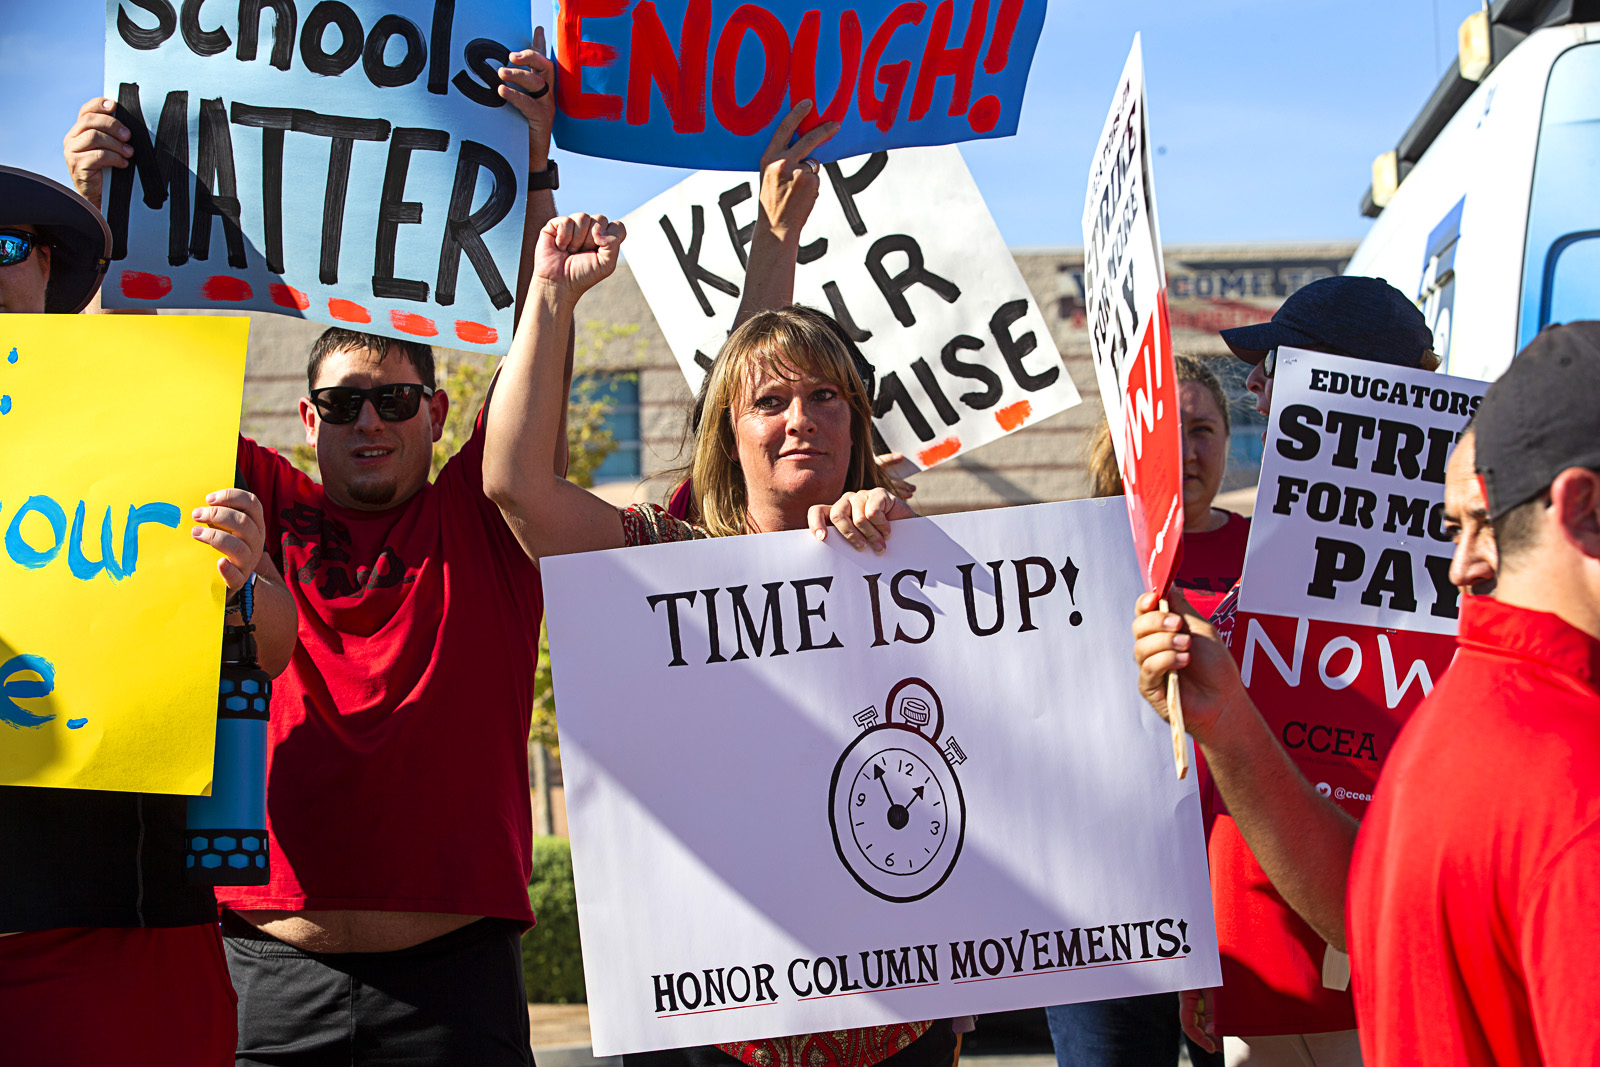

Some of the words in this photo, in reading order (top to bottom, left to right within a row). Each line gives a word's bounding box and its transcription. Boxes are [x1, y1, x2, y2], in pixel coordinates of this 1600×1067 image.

[557, 0, 1024, 145] ENOUGH!
[106, 82, 514, 310] MATTER
[659, 150, 888, 316] KEP
[872, 299, 1060, 454] MISE
[1276, 404, 1462, 485] STRI
[1273, 475, 1377, 529] FOR
[1383, 494, 1456, 542] MO
[646, 576, 844, 667] TIME
[863, 569, 935, 648] IS
[956, 556, 1083, 637] UP!
[1307, 537, 1459, 619] PAY
[898, 760, 914, 776] 12
[1282, 720, 1378, 761] CCEA
[856, 793, 866, 806] 9
[930, 821, 940, 835] 3
[885, 853, 894, 866] 6
[652, 963, 778, 1013] HONOR
[788, 944, 938, 997] COLUMN
[950, 918, 1192, 981] MOVEMENTS!
